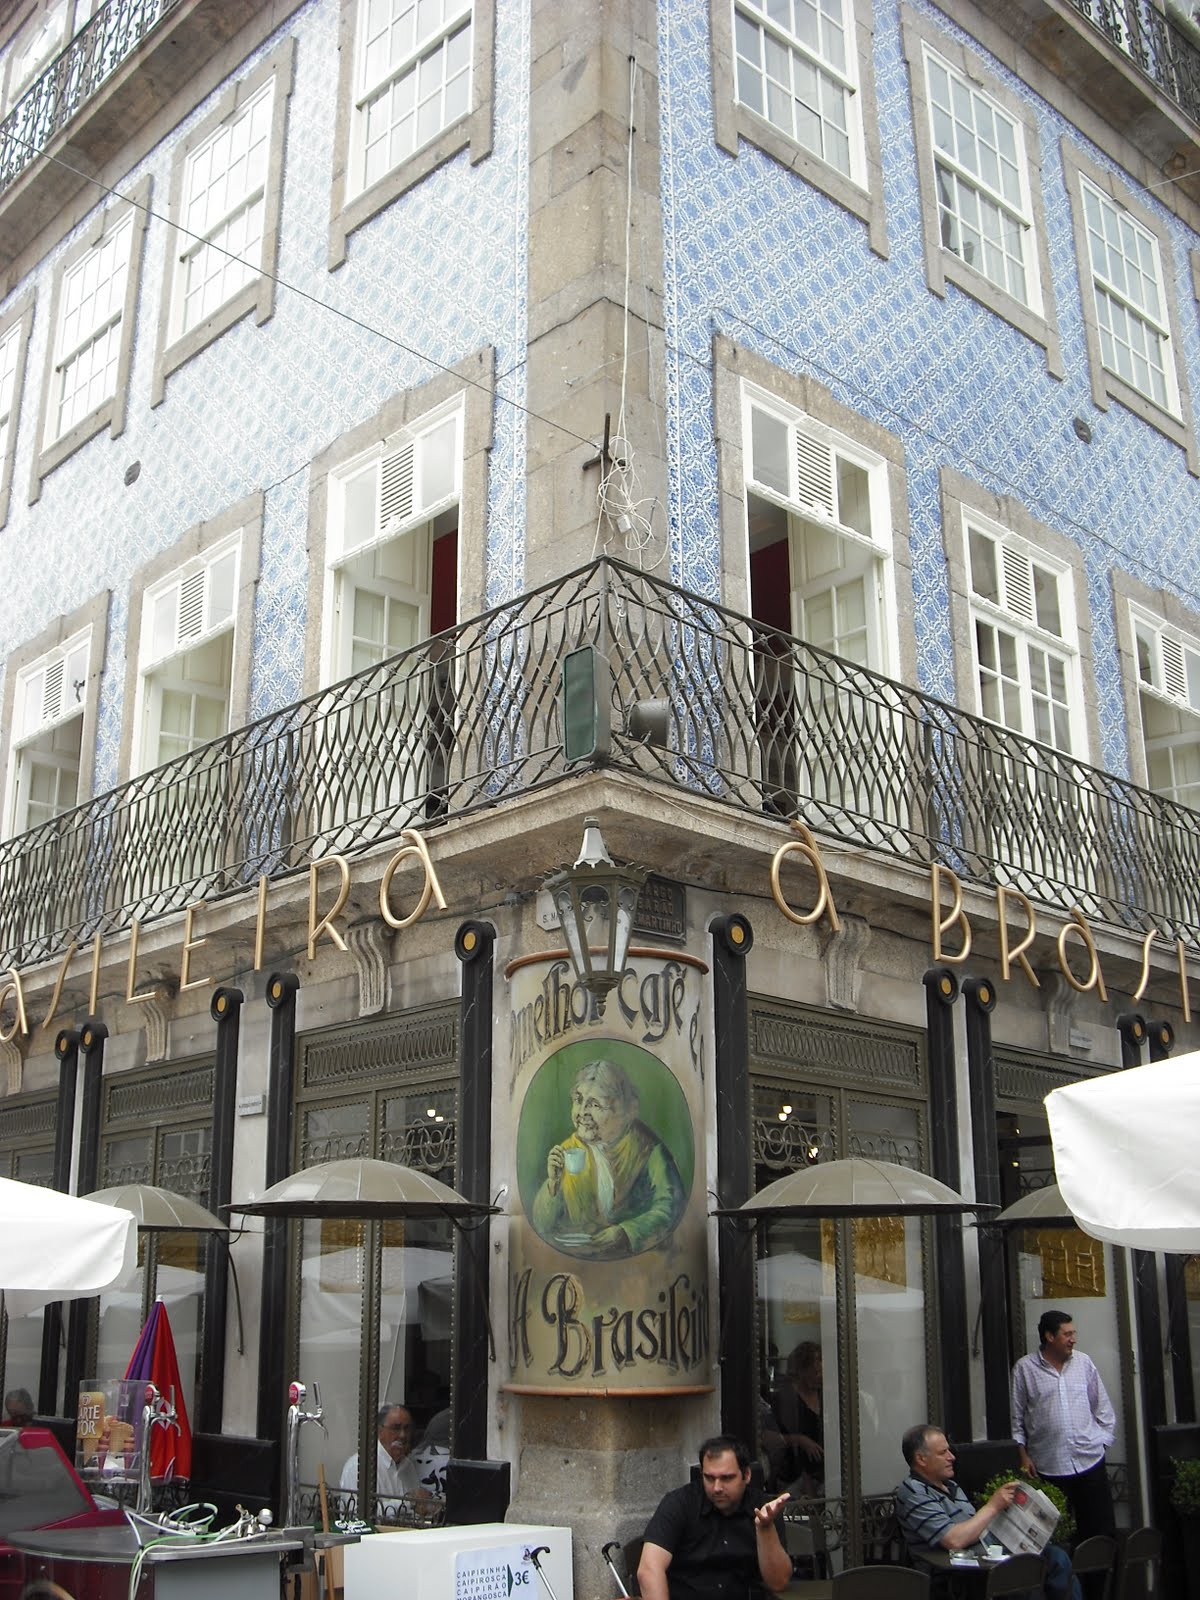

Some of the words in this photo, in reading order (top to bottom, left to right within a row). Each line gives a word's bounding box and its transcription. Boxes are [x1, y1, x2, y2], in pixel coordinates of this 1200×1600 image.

[641, 882, 673, 900] ARGO
[78, 1404, 101, 1421] ARTE
[77, 1419, 97, 1436] 'OR
[456, 1565, 507, 1579] CAIPIRINHA
[514, 1570, 530, 1587] 3€
[456, 1574, 507, 1588] CAIPIROSCA
